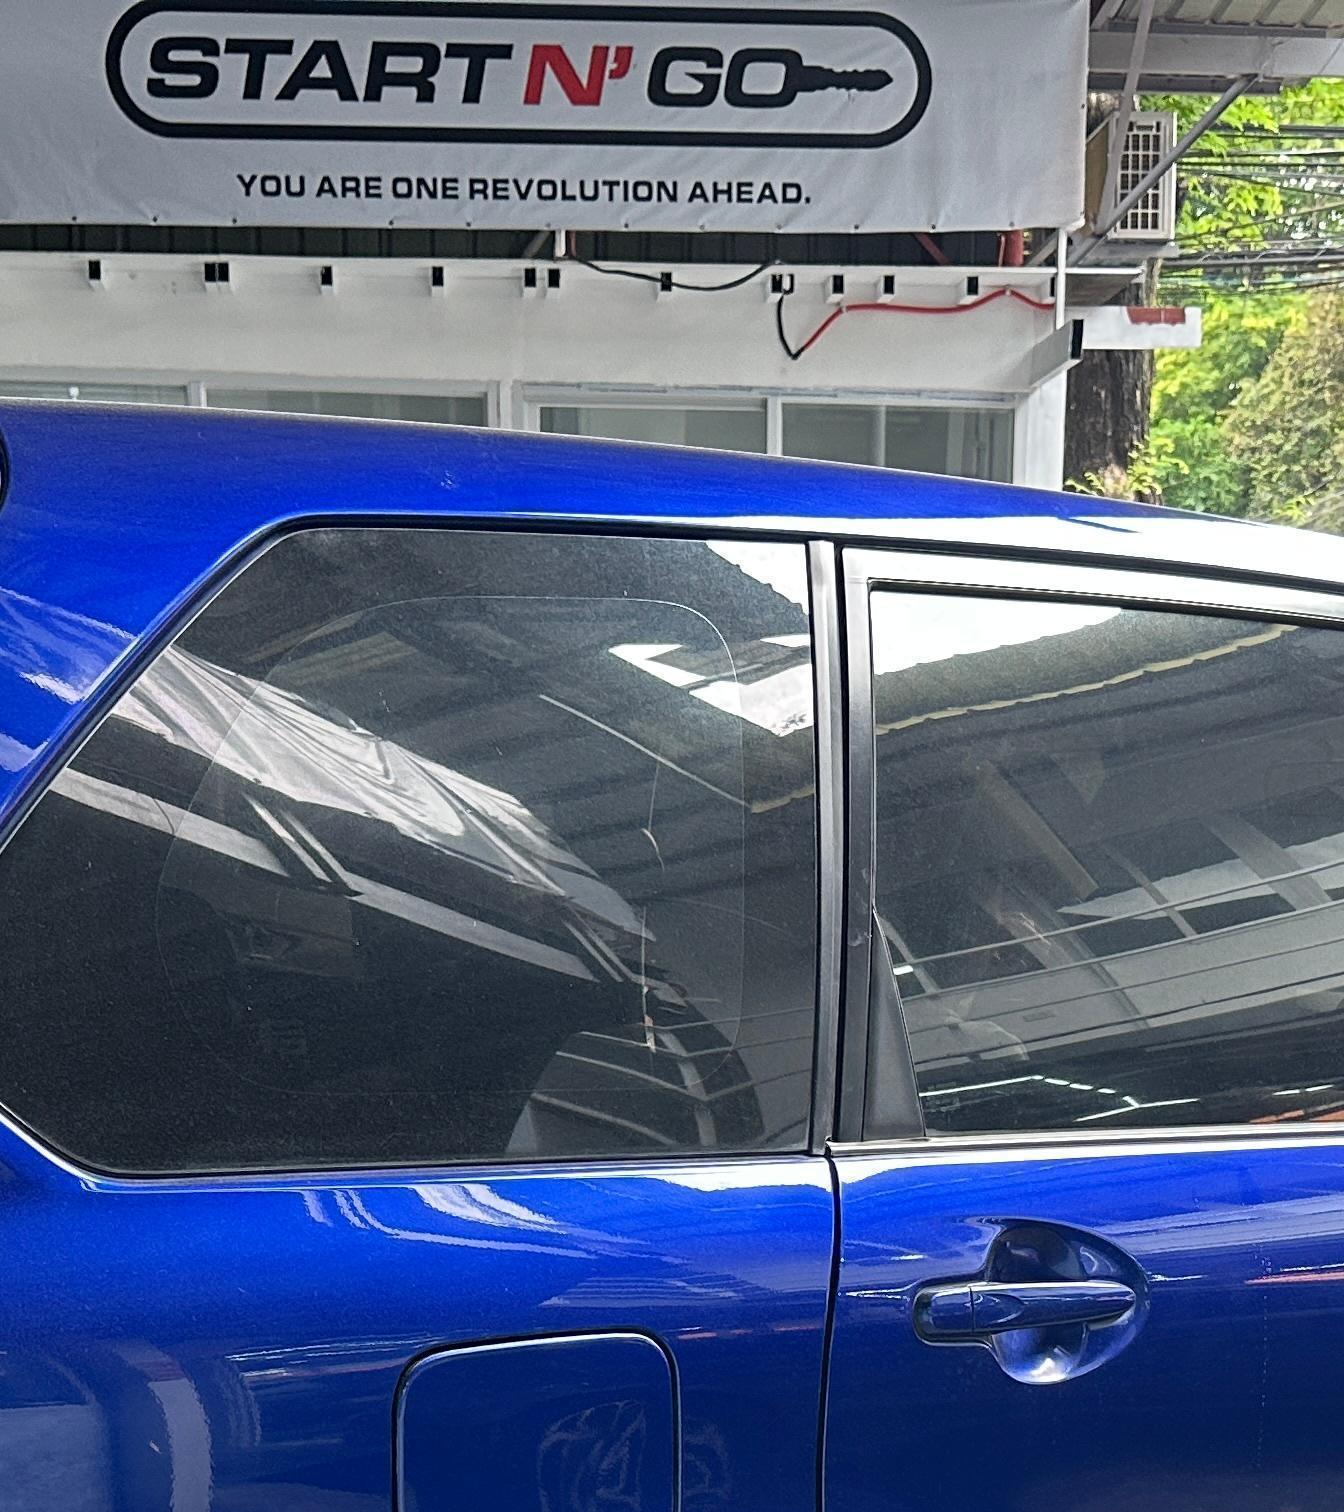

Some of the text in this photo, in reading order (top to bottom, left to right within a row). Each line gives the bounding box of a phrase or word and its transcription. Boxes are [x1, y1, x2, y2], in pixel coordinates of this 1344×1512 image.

[146, 36, 803, 108] START N' GO
[236, 174, 811, 204] YOU ARE ONE REVOLUTION AHEAD.
